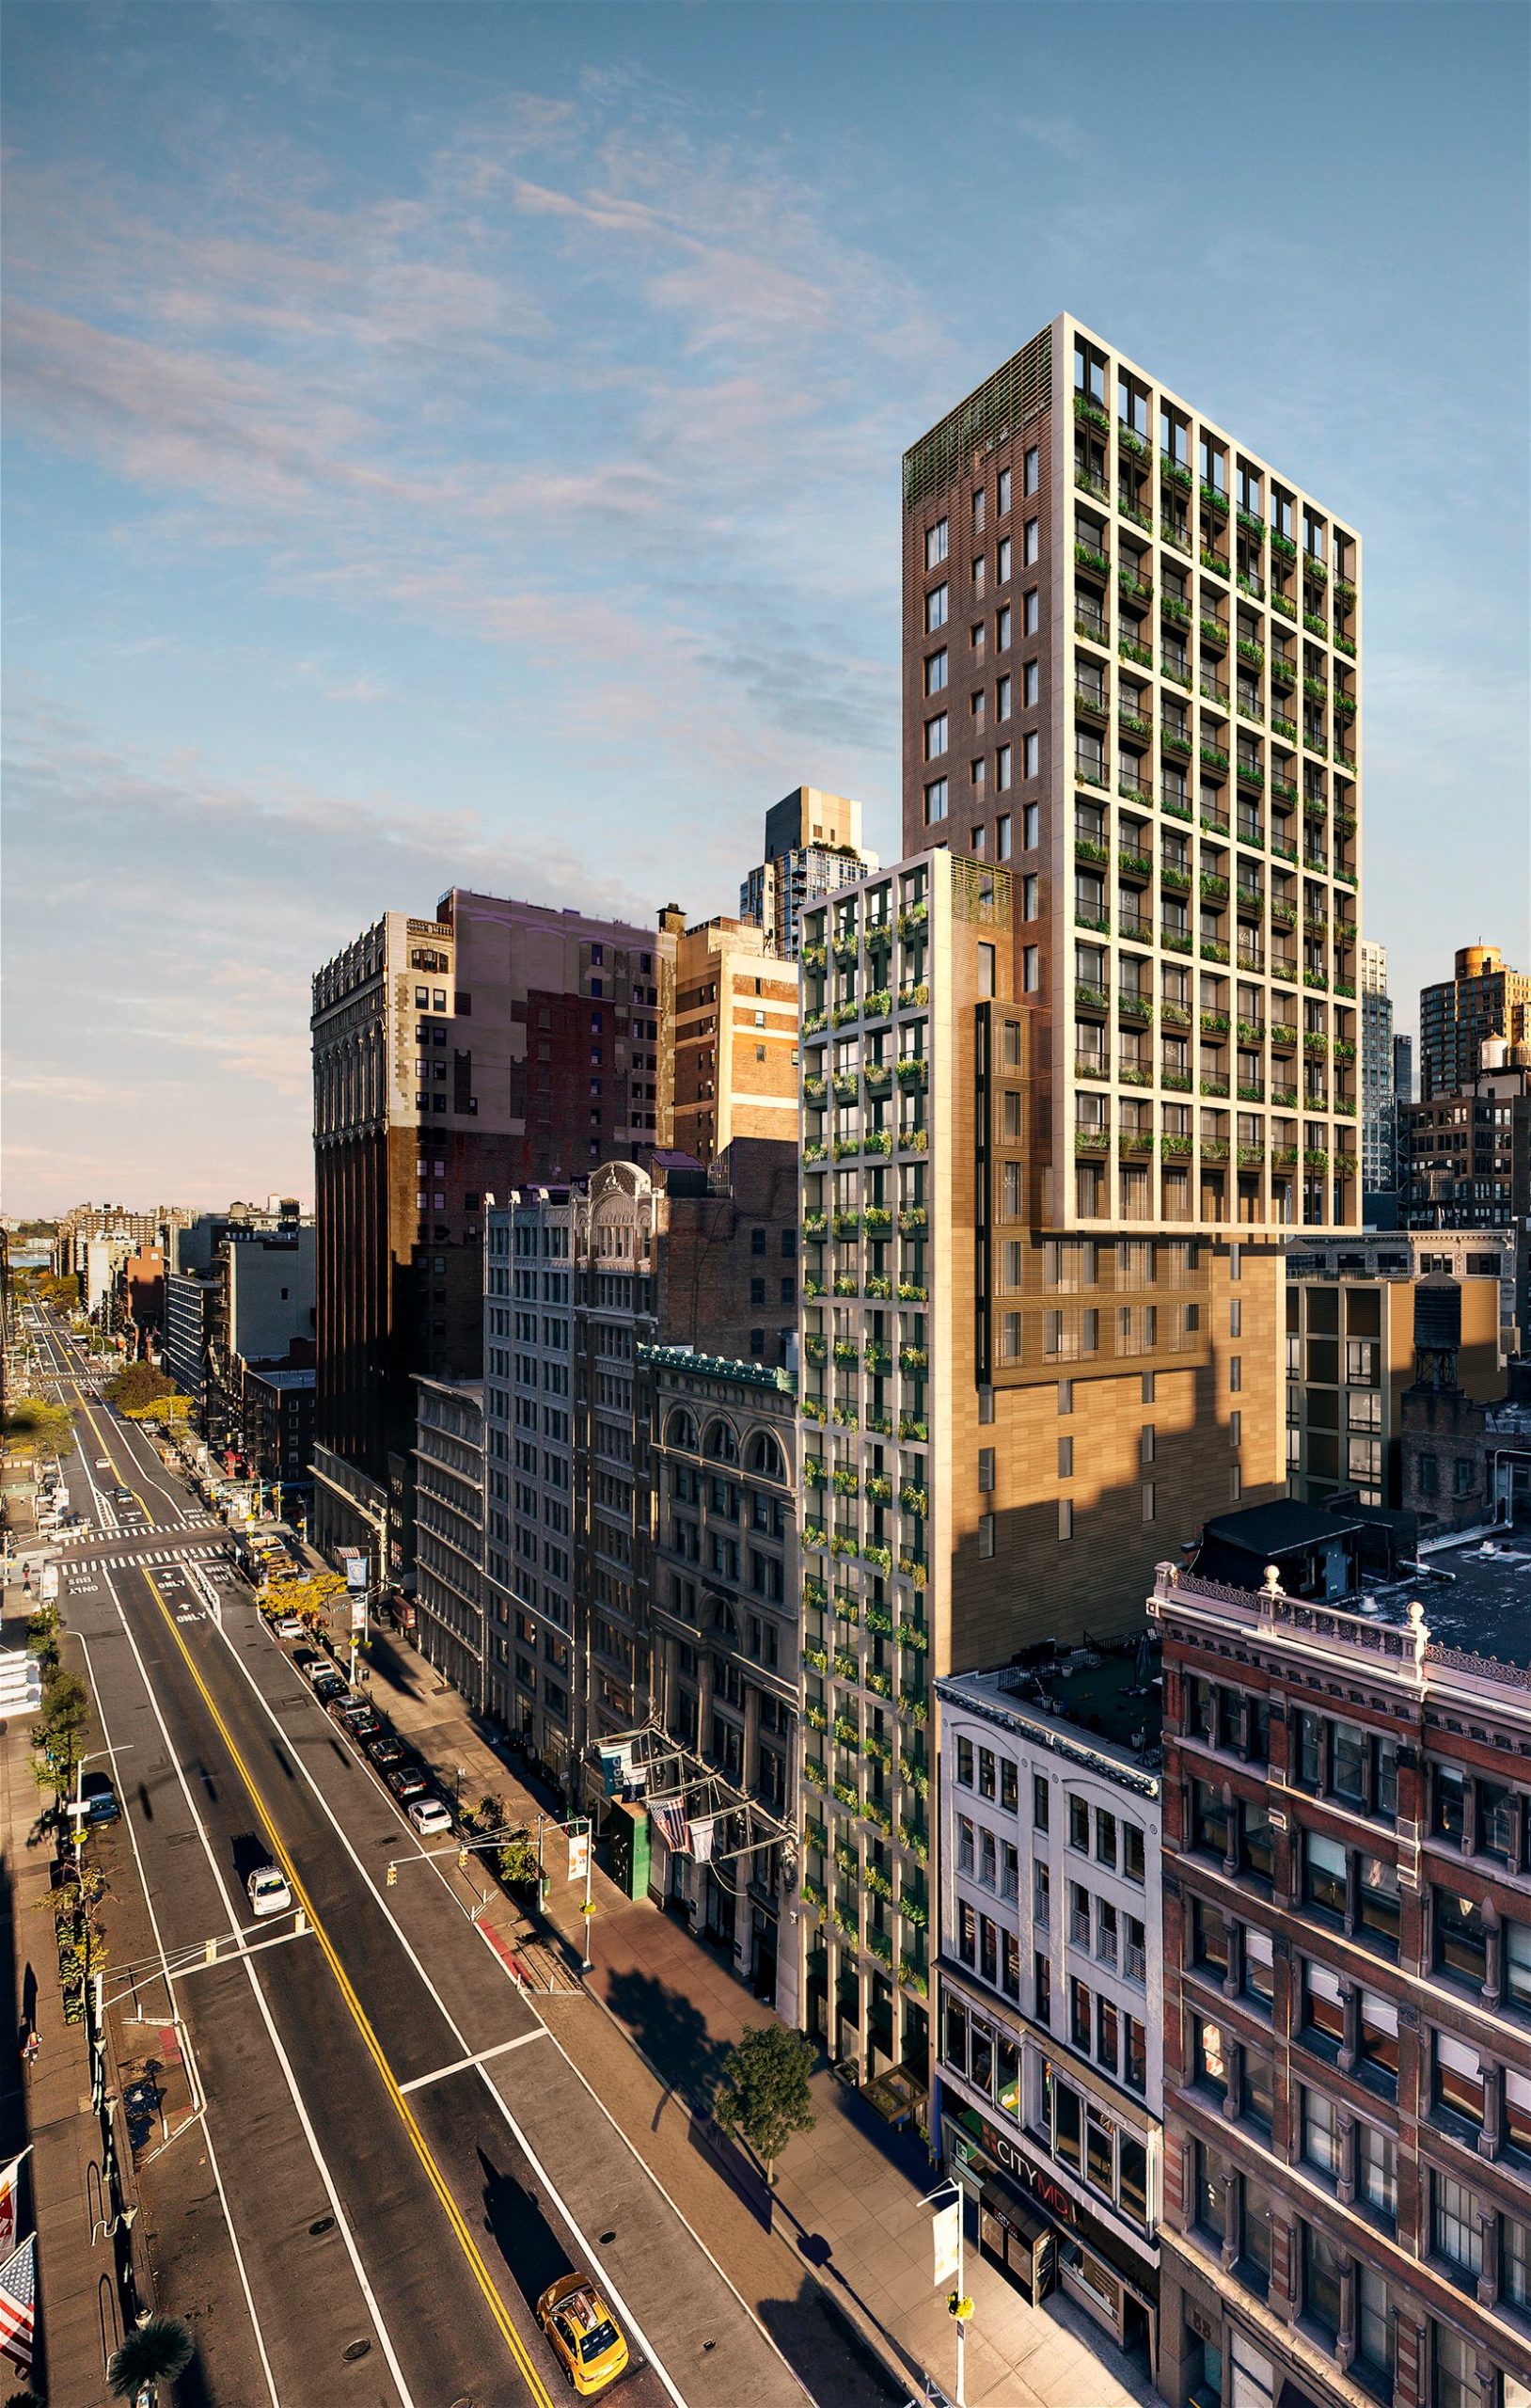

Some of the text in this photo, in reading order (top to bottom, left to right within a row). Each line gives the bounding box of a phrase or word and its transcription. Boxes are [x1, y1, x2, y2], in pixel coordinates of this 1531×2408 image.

[205, 1564, 231, 1574] ONLY
[68, 1576, 92, 1585] BUS
[213, 1574, 236, 1582] BUS
[157, 1579, 186, 1590] ONLY
[68, 1585, 100, 1595] ONLY
[176, 1611, 208, 1624] ONLY
[997, 2140, 1068, 2215] CITYMD
